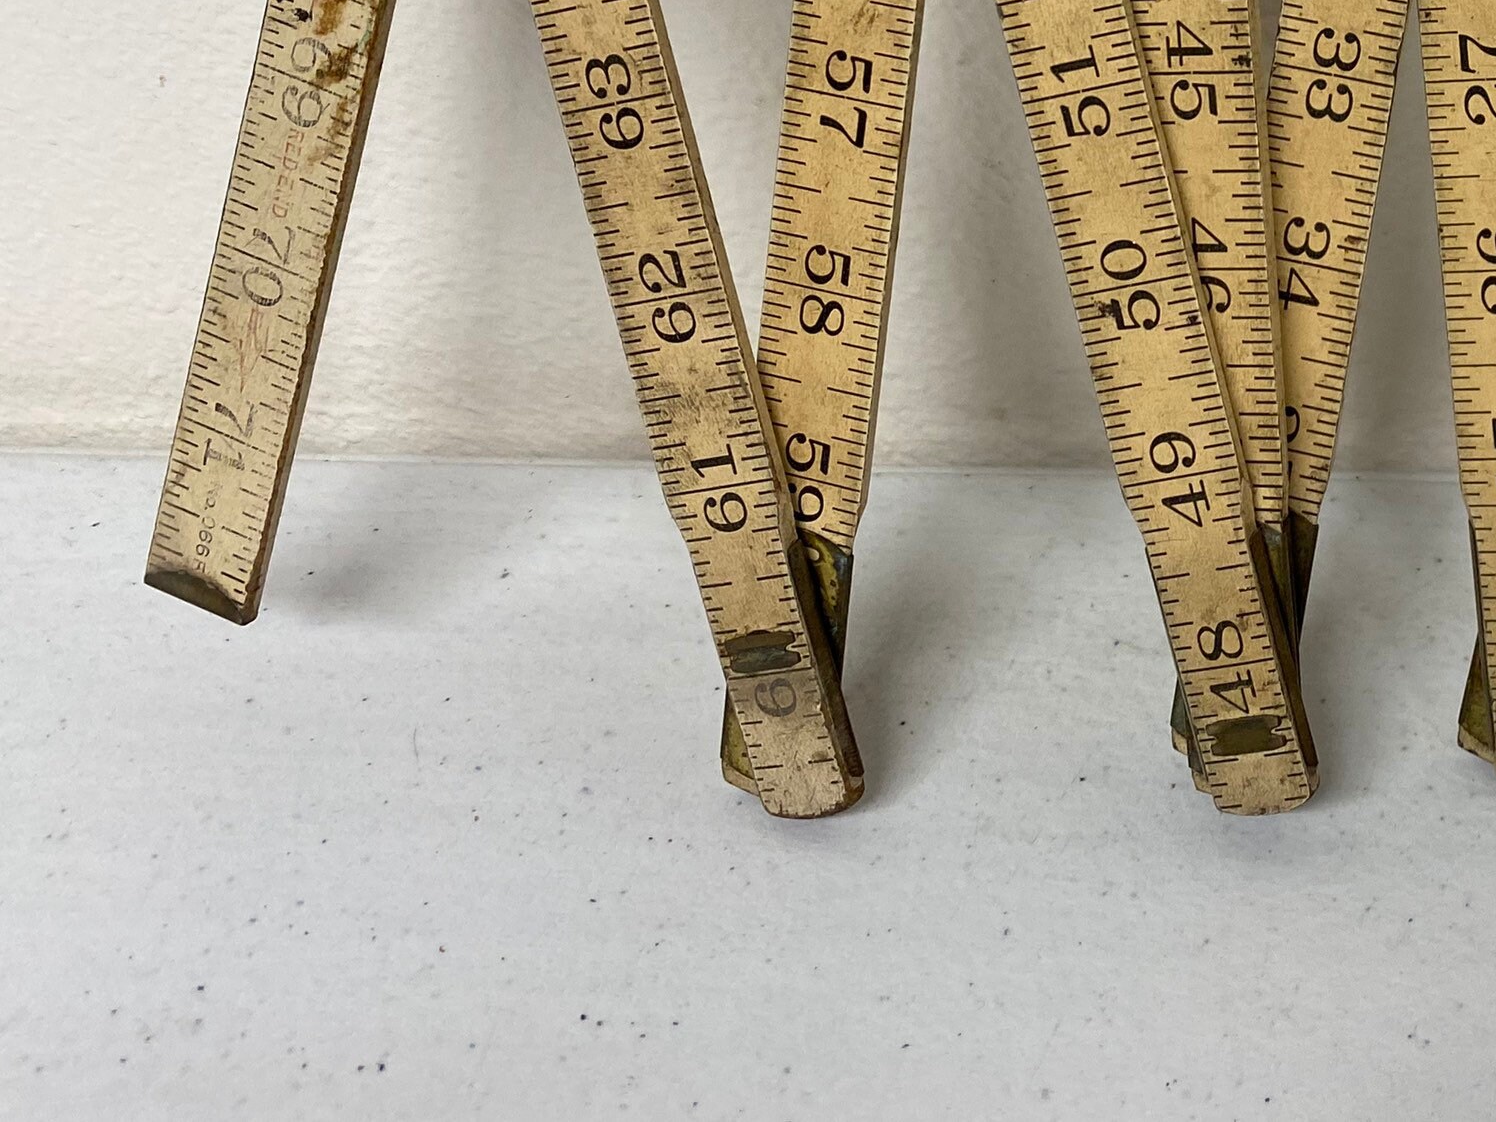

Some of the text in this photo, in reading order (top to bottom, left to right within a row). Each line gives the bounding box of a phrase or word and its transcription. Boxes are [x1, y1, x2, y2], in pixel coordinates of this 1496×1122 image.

[282, 37, 333, 127] 69
[585, 54, 644, 150] 63
[819, 49, 873, 149] 57
[1050, 44, 1111, 138] 51
[1166, 20, 1218, 121] 45
[1305, 27, 1362, 123] 33
[272, 128, 305, 219] RED END
[242, 226, 296, 307] 70
[638, 249, 697, 343] 62
[799, 244, 851, 337] 58
[1100, 239, 1161, 330] 50
[1278, 216, 1331, 311] 34
[203, 401, 258, 471] 71
[785, 433, 831, 523] 59
[1149, 431, 1211, 528] 49
[690, 443, 748, 533] 61
[1196, 619, 1257, 715] 48
